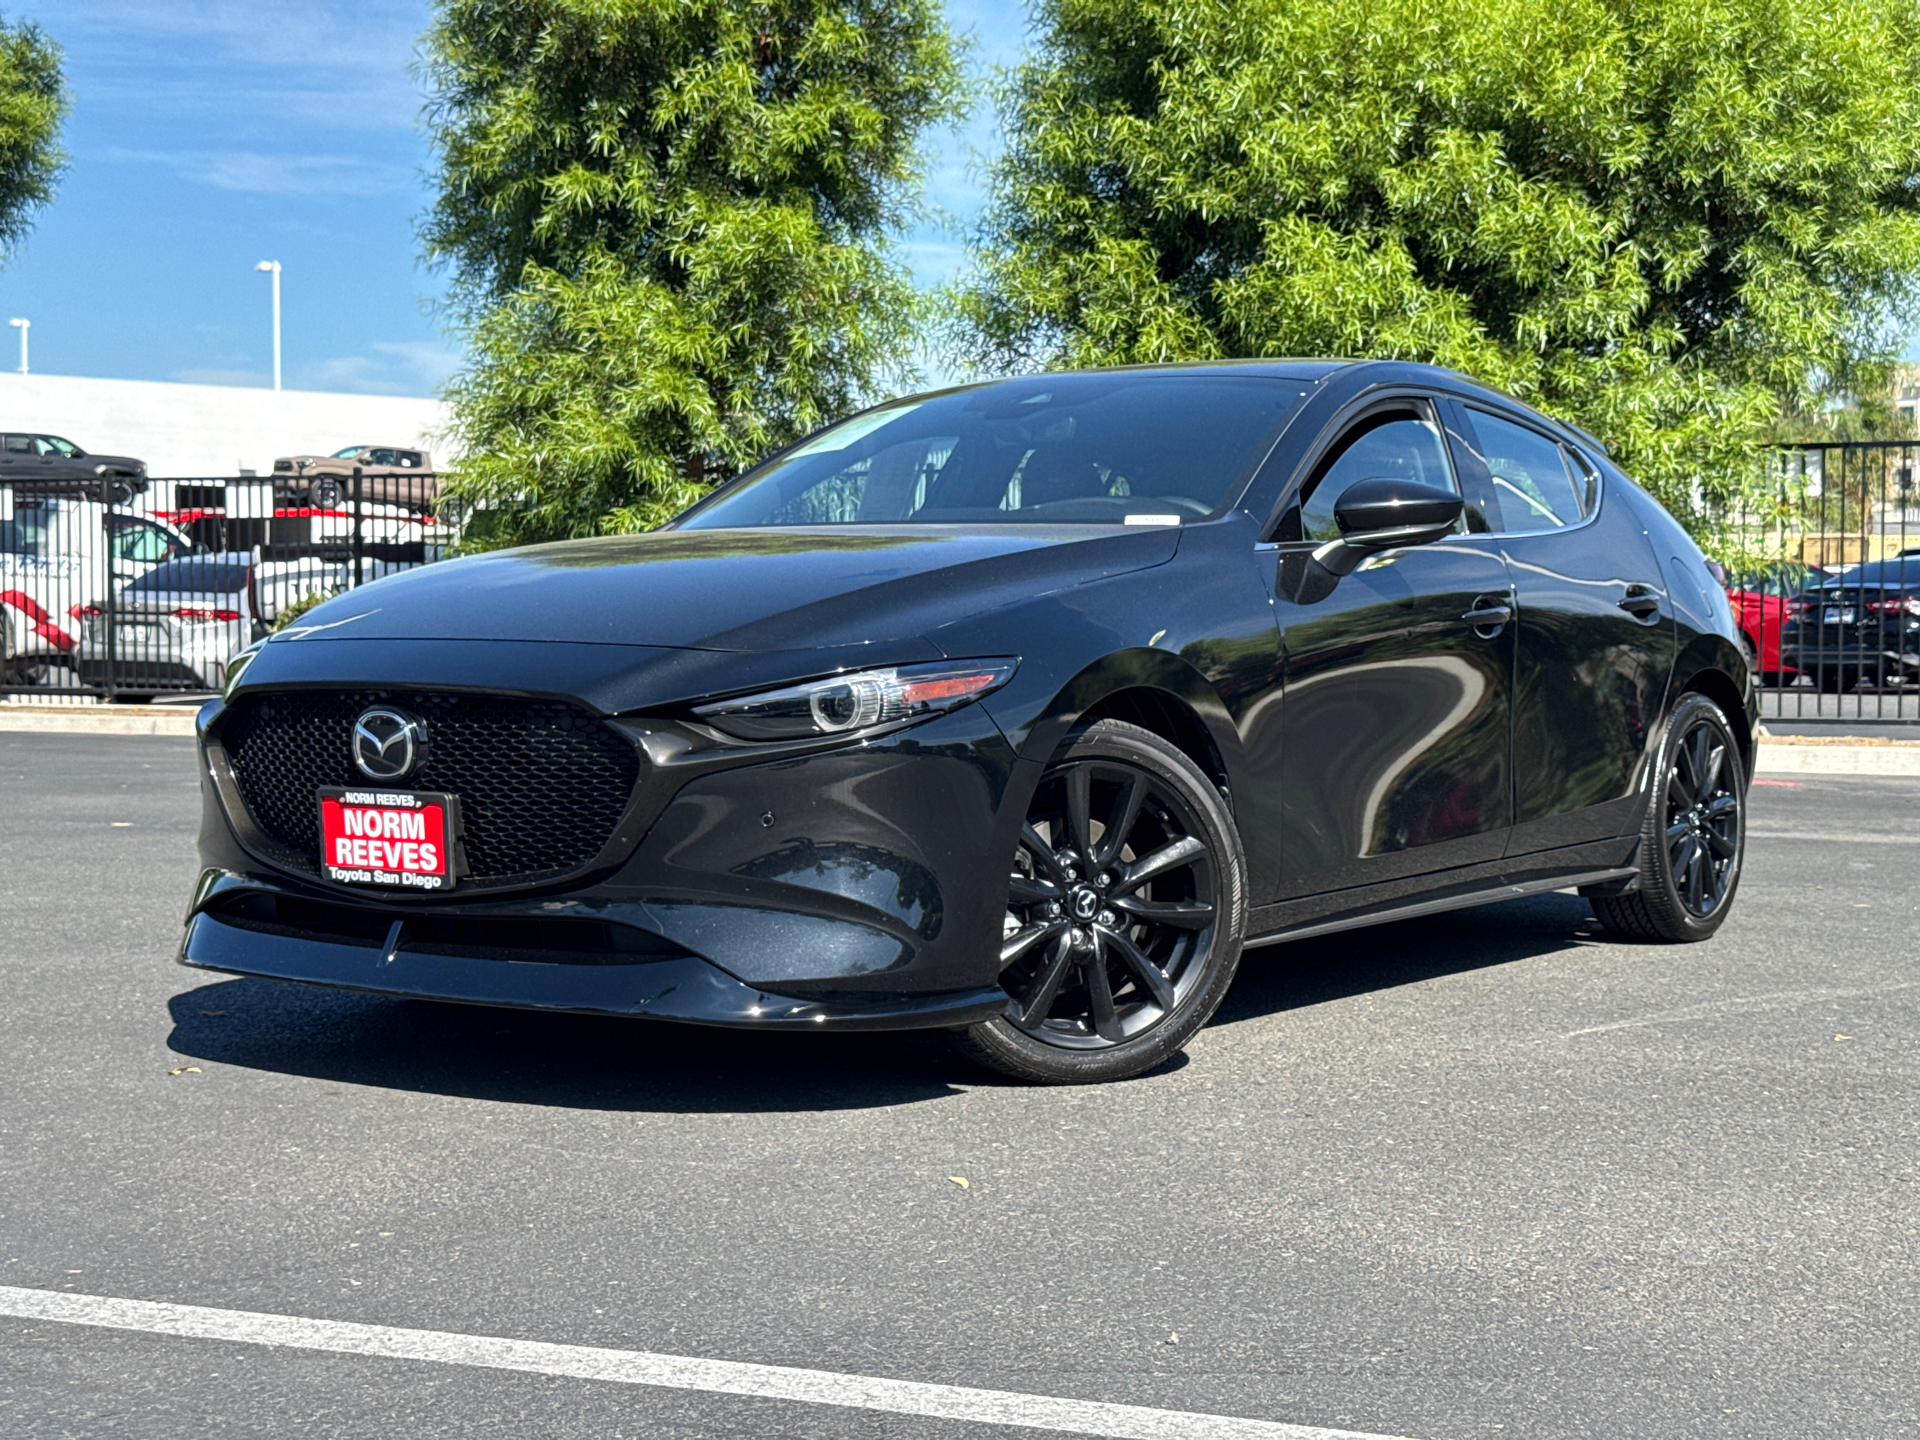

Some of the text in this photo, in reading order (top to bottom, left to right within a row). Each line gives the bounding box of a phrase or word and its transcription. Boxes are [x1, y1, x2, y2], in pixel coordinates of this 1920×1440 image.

[345, 792, 415, 807] NORM REEVES
[343, 809, 426, 840] NORM
[335, 837, 438, 871] REEVES
[328, 866, 442, 889] Toyota San Diego
